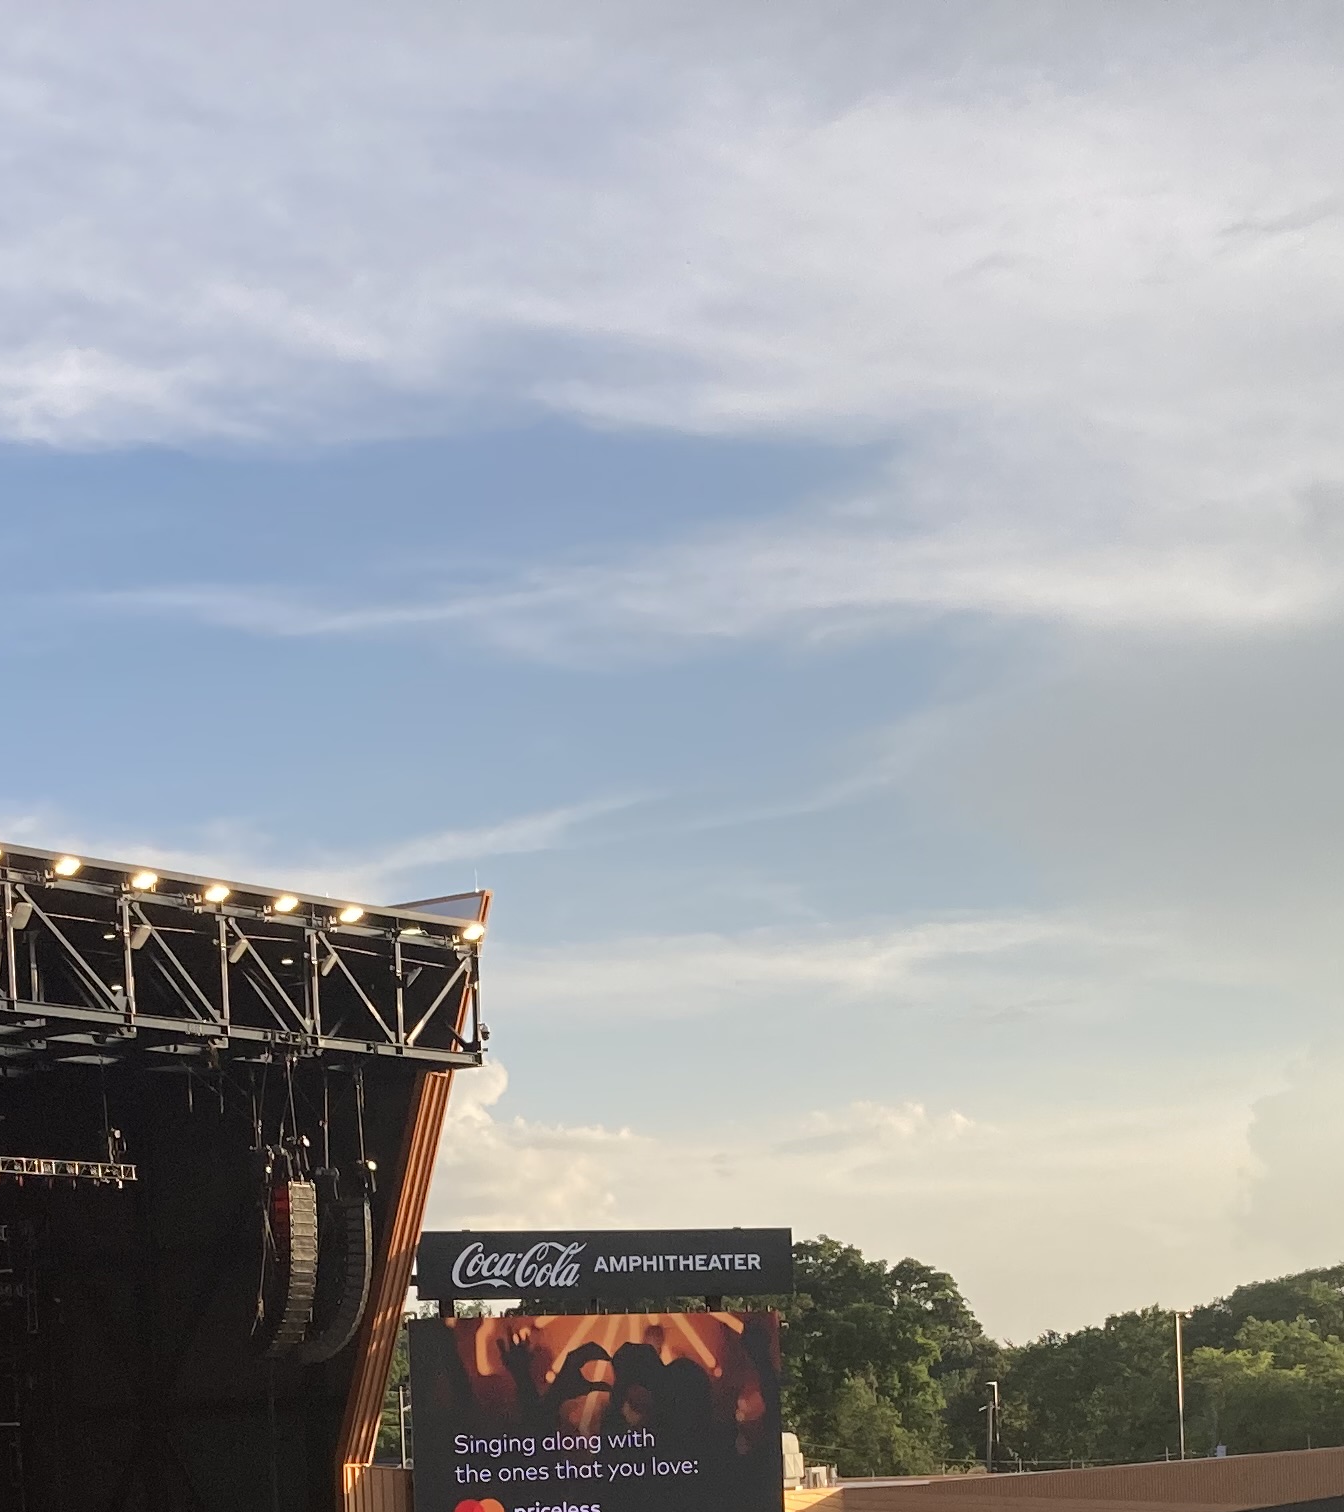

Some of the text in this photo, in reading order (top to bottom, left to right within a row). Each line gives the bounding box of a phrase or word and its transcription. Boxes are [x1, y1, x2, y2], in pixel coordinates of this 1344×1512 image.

[451, 1241, 761, 1288] Coca-Cola AMPHITHEATER
[454, 1428, 655, 1457] Singing along with
[454, 1457, 699, 1484] the ones that you love:
